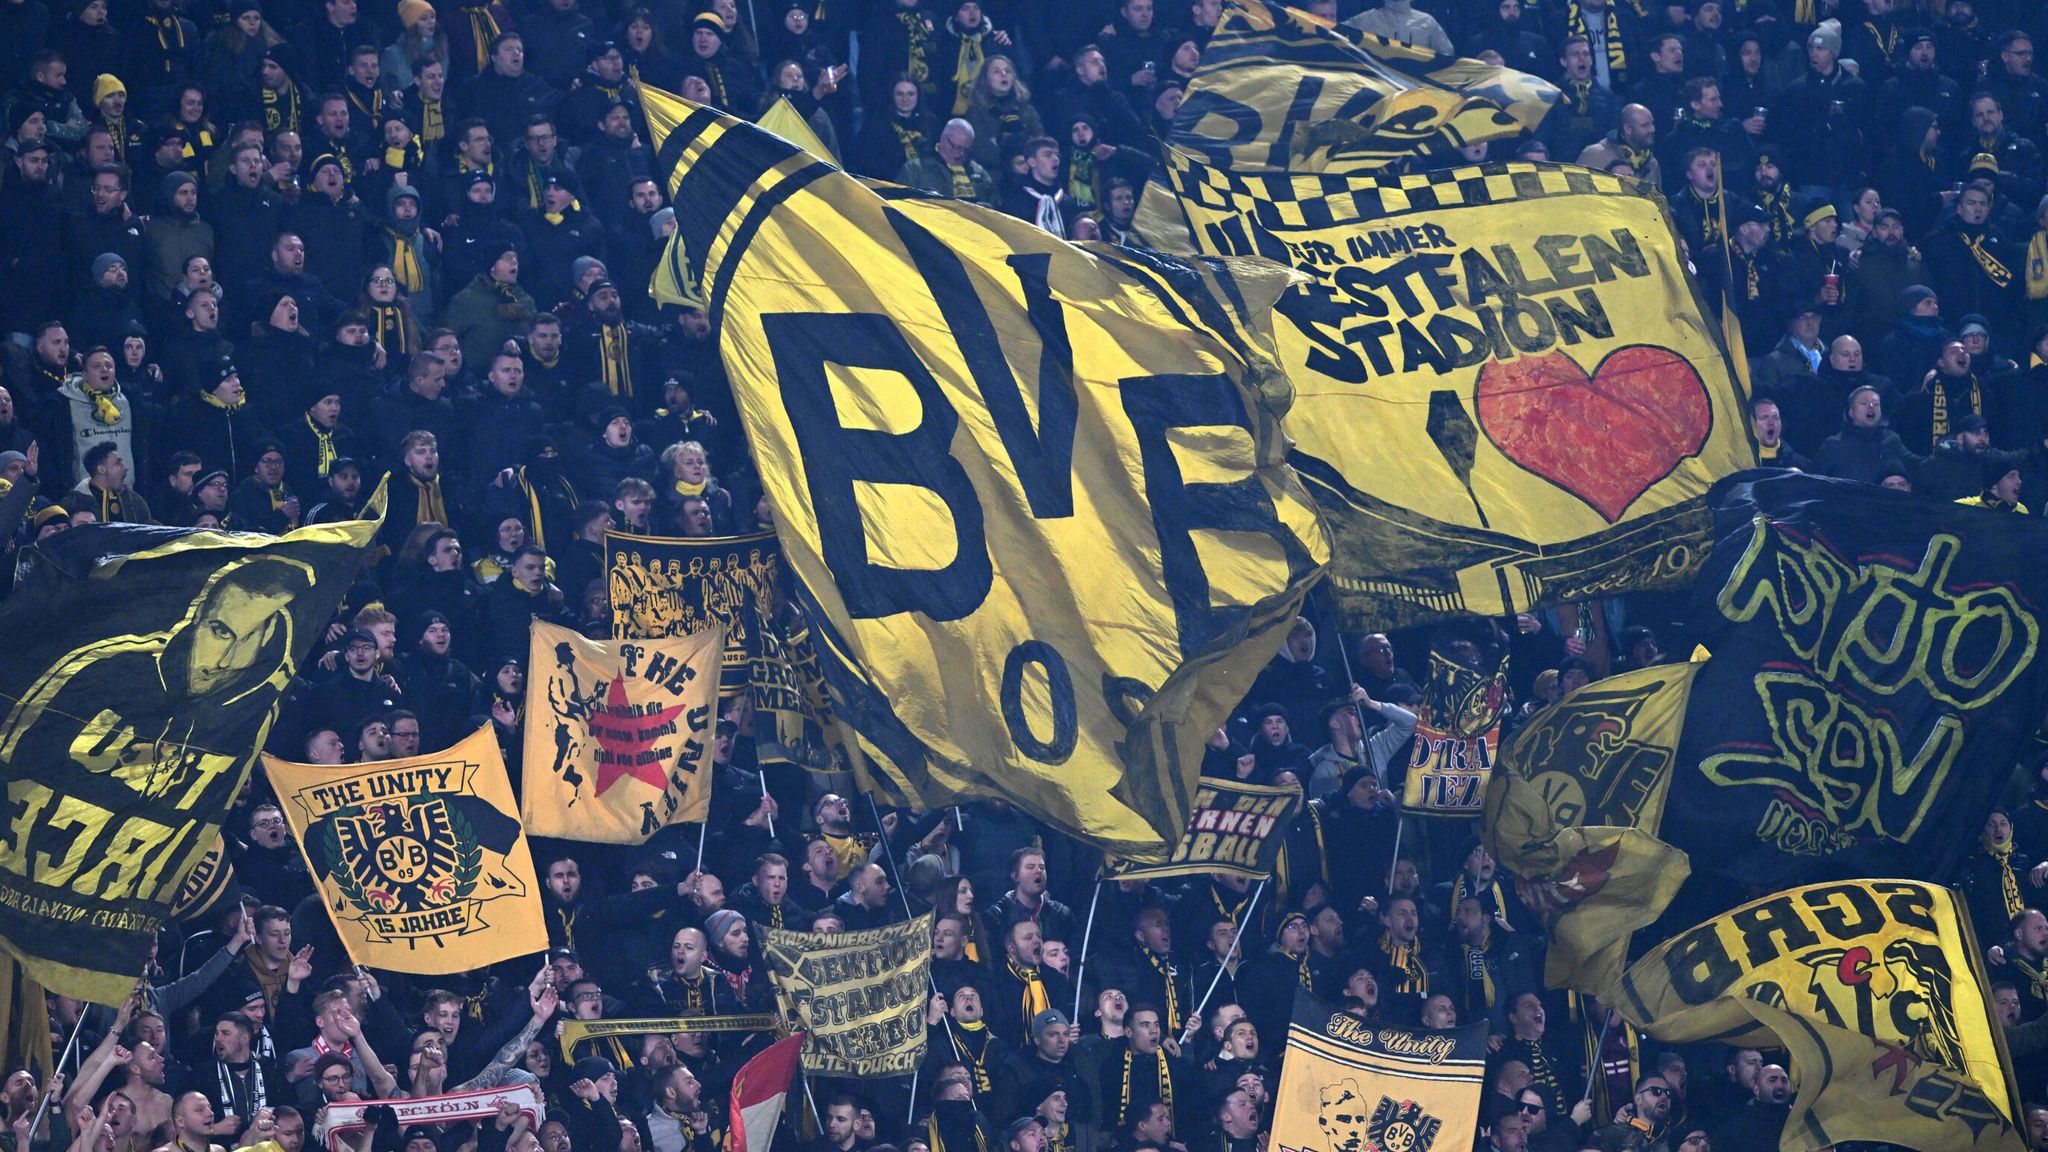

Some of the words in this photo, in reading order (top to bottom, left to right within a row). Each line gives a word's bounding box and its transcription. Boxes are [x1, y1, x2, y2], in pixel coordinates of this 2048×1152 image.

[1346, 222, 1457, 263] IMMER
[1285, 227, 1650, 320] ESTFALEN
[1305, 288, 1615, 384] STADION
[760, 207, 1315, 658] BVB
[620, 643, 697, 697] THE
[311, 781, 365, 810] THE
[366, 767, 453, 798] UNITY
[379, 838, 427, 873] BVB
[398, 867, 414, 880] 09
[374, 918, 395, 934] 15
[398, 909, 466, 934] JAHRE
[811, 959, 929, 1028] STADION
[1327, 1013, 1373, 1046] The
[1379, 1028, 1457, 1066] Unity
[857, 1051, 916, 1076] DURCH
[426, 1100, 481, 1115] KÖLN
[1386, 1124, 1415, 1148] BVB
